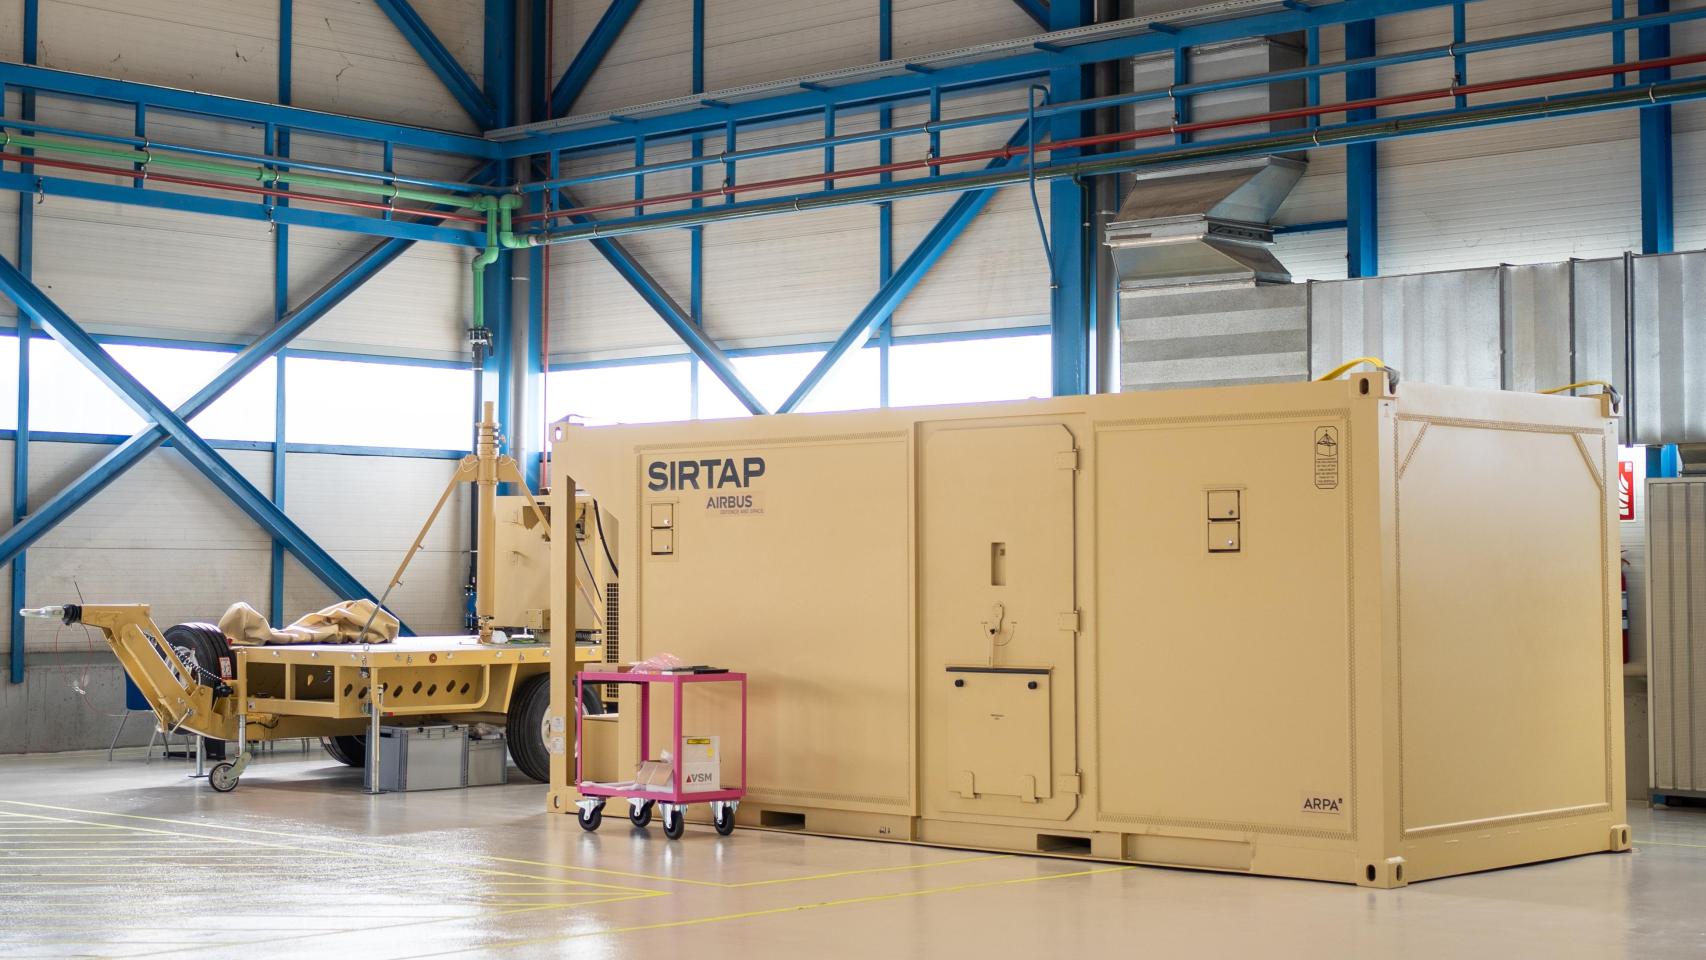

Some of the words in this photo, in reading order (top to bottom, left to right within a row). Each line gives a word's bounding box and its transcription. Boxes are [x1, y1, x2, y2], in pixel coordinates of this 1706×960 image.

[648, 457, 766, 492] SIRTAP
[706, 495, 753, 509] AIRBUS
[691, 773, 712, 783] VSM
[1304, 798, 1339, 811] ARPA
